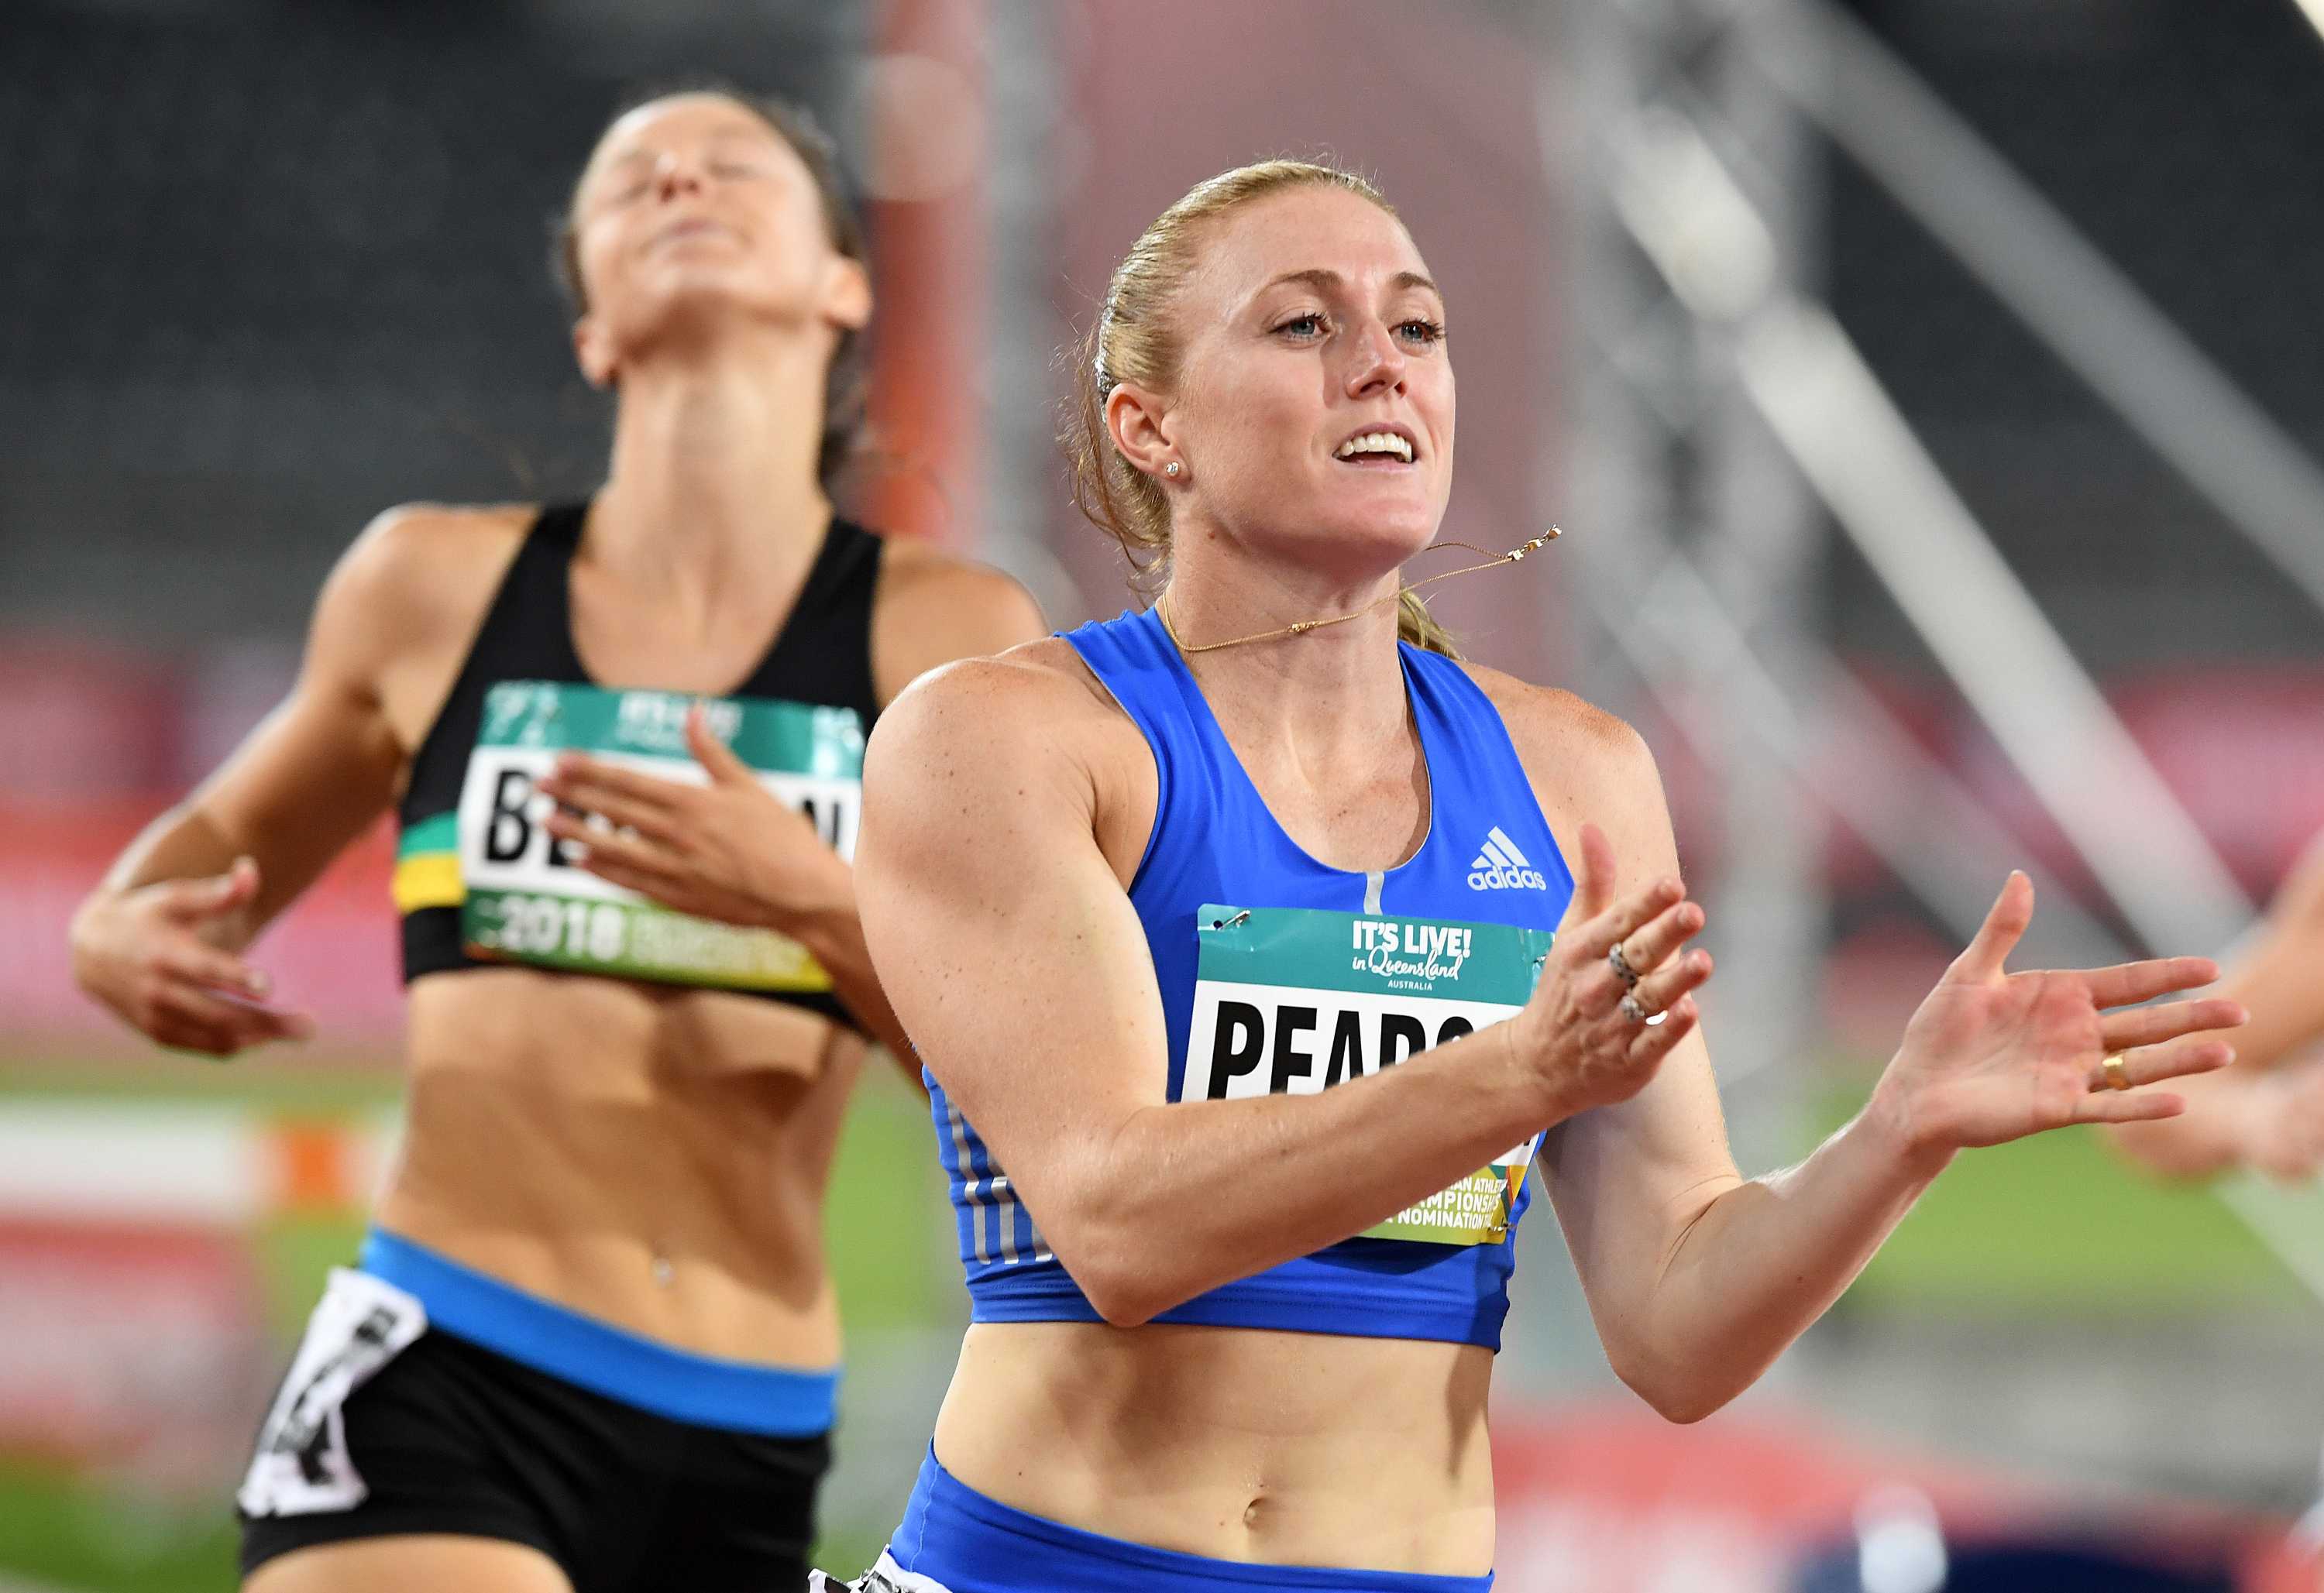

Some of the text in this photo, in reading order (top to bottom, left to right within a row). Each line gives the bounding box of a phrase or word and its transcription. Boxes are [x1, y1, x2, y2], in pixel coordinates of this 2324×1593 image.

[1467, 865, 1547, 891] adidas
[1352, 920, 1472, 958] IT'S LIVE!
[1352, 945, 1463, 980] in Queensland
[1387, 980, 1433, 991] AUSTRALIA
[1397, 1207, 1484, 1231] NOMINATION
